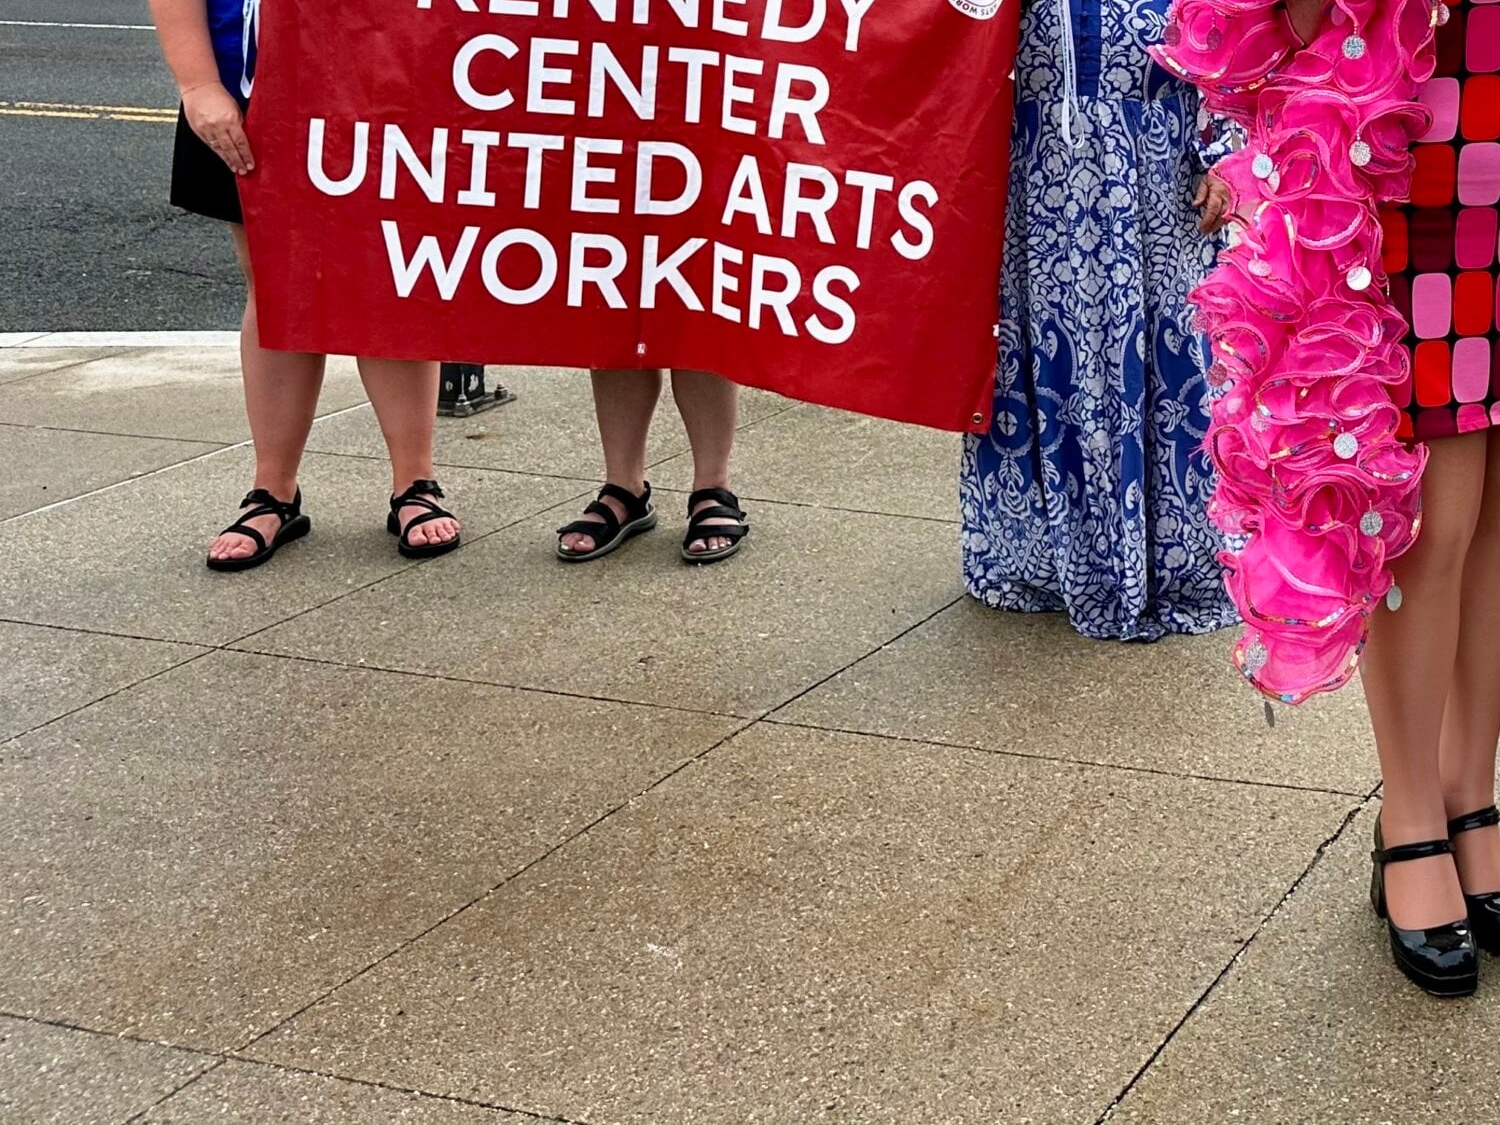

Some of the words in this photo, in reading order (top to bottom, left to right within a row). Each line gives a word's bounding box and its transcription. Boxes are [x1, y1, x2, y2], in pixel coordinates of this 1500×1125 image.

[452, 33, 830, 145] CENTER
[307, 118, 702, 216] UNITED
[721, 154, 939, 260] ARTS
[381, 220, 861, 345] WORKERS
